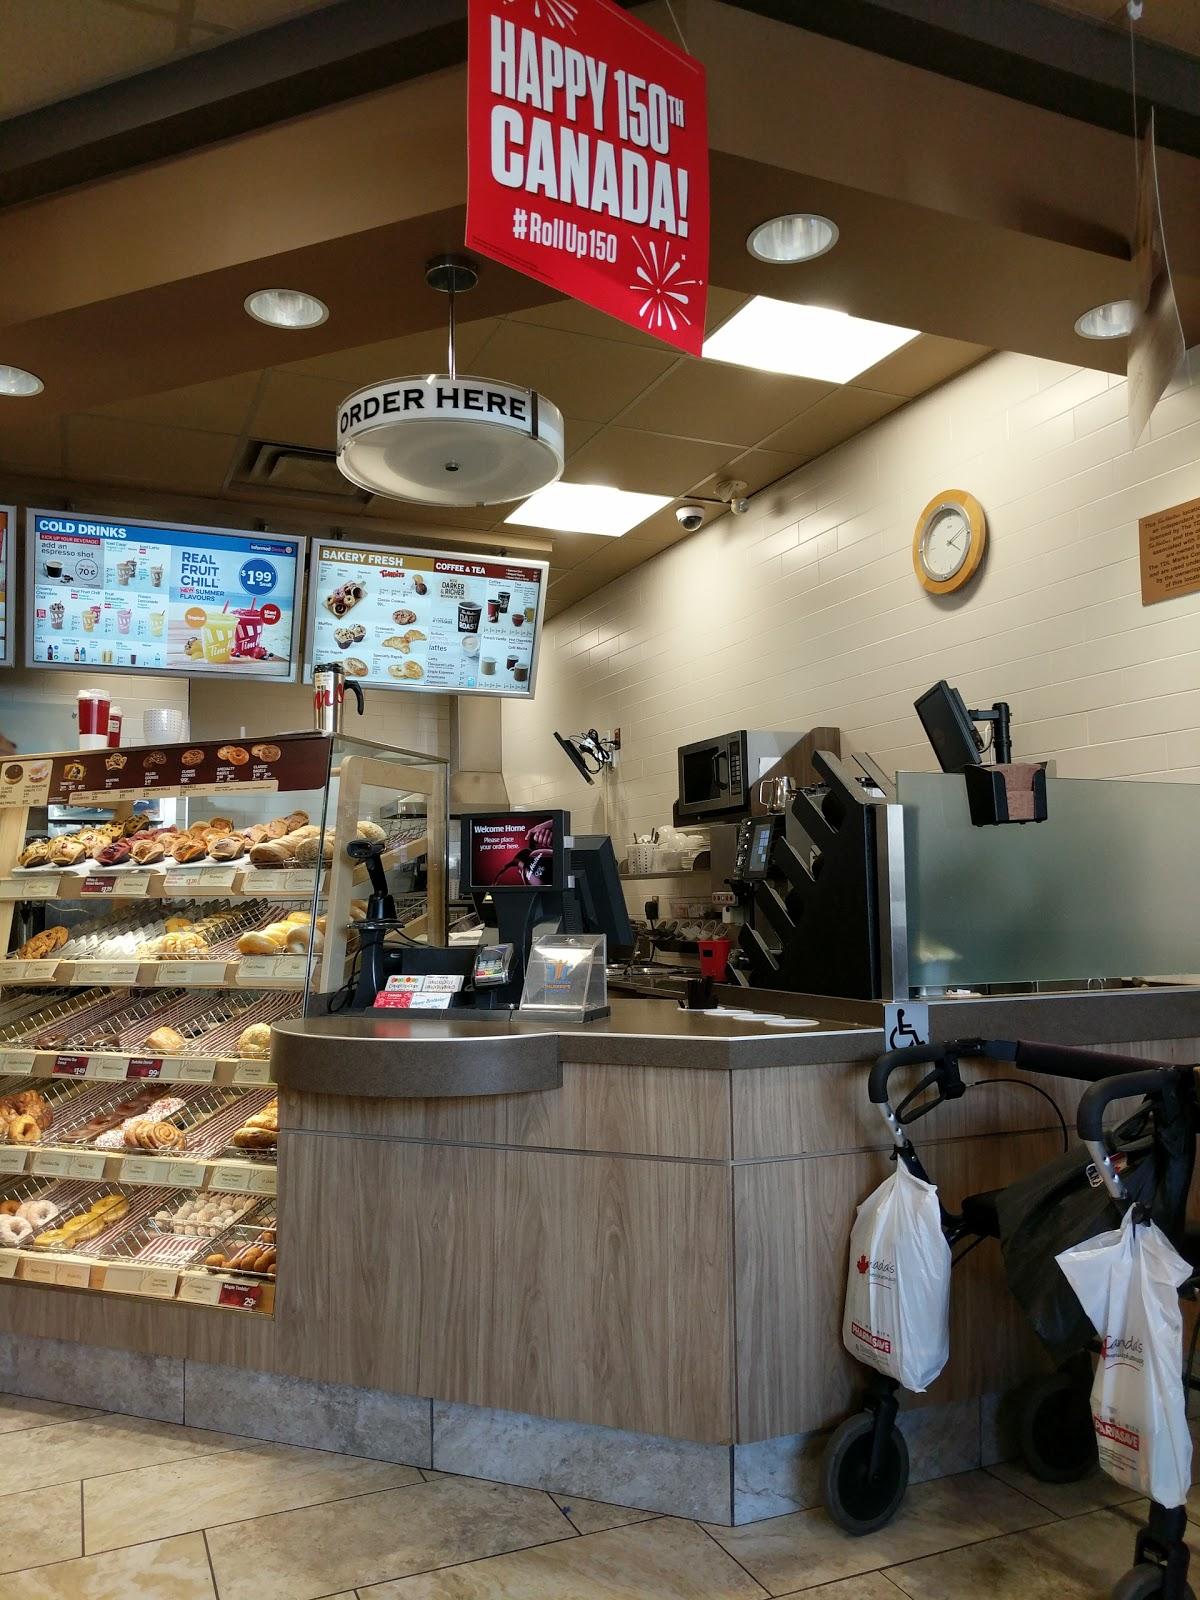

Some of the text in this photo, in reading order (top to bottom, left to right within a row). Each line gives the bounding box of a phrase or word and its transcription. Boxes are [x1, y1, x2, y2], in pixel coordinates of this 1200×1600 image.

[490, 15, 608, 131] HAPPY
[490, 104, 689, 238] CANADA!
[340, 388, 527, 434] ORDER HERE
[39, 520, 127, 539] COLD DRINKS
[41, 548, 94, 559] espresso shot
[181, 552, 216, 565] REAL
[322, 550, 403, 566] BAKERY FRESH
[181, 564, 219, 577] FRUIT
[435, 562, 464, 572] COFFEE
[471, 566, 486, 574] TEA
[195, 588, 225, 596] SUMMER
[441, 581, 465, 590] DARKER
[180, 593, 215, 602] FLAVOURS
[474, 825, 504, 833] Welcome
